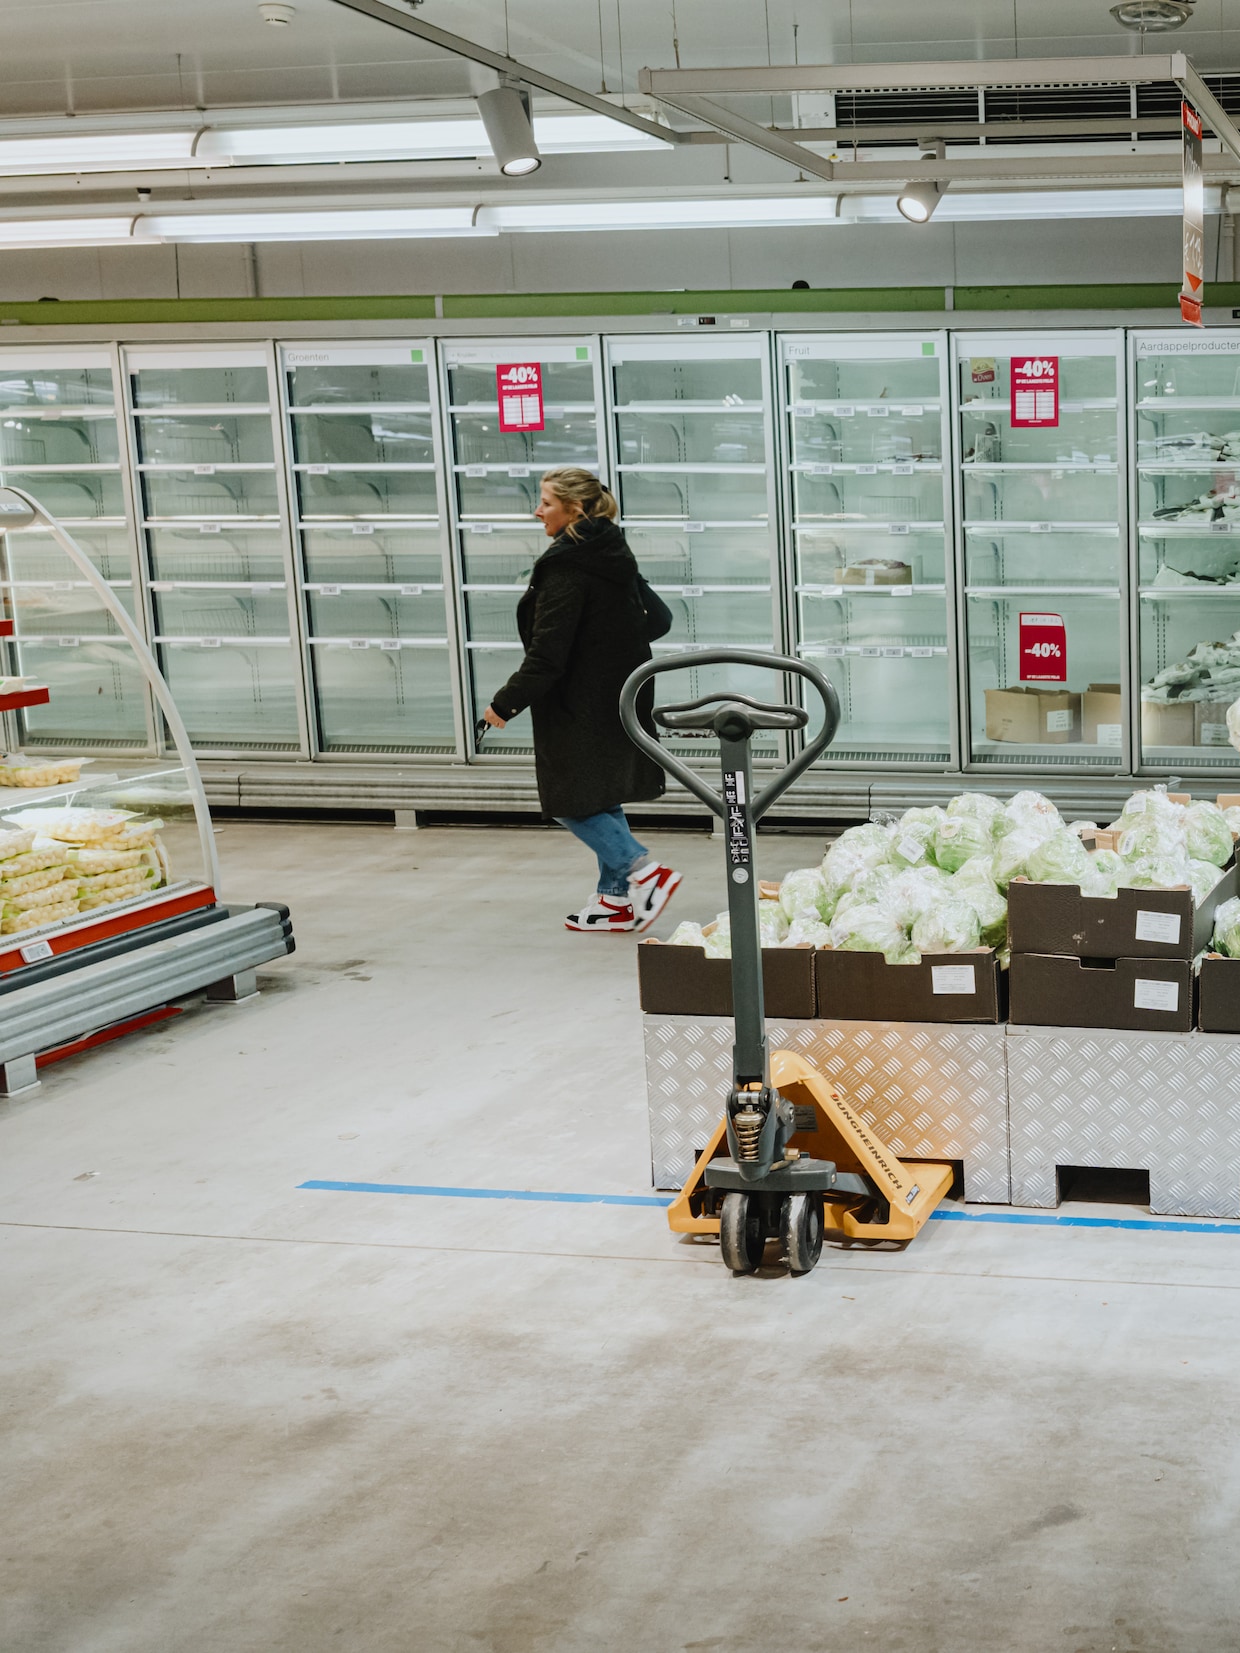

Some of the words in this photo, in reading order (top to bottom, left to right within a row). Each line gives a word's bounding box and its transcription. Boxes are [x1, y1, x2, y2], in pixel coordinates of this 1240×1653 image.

[287, 351, 330, 362] Groenten
[788, 345, 810, 356] Fruit
[501, 366, 539, 384] -40%
[1014, 360, 1055, 377] -40%
[1024, 642, 1061, 658] -40%
[831, 1093, 903, 1190] JUNGHEINRICH
